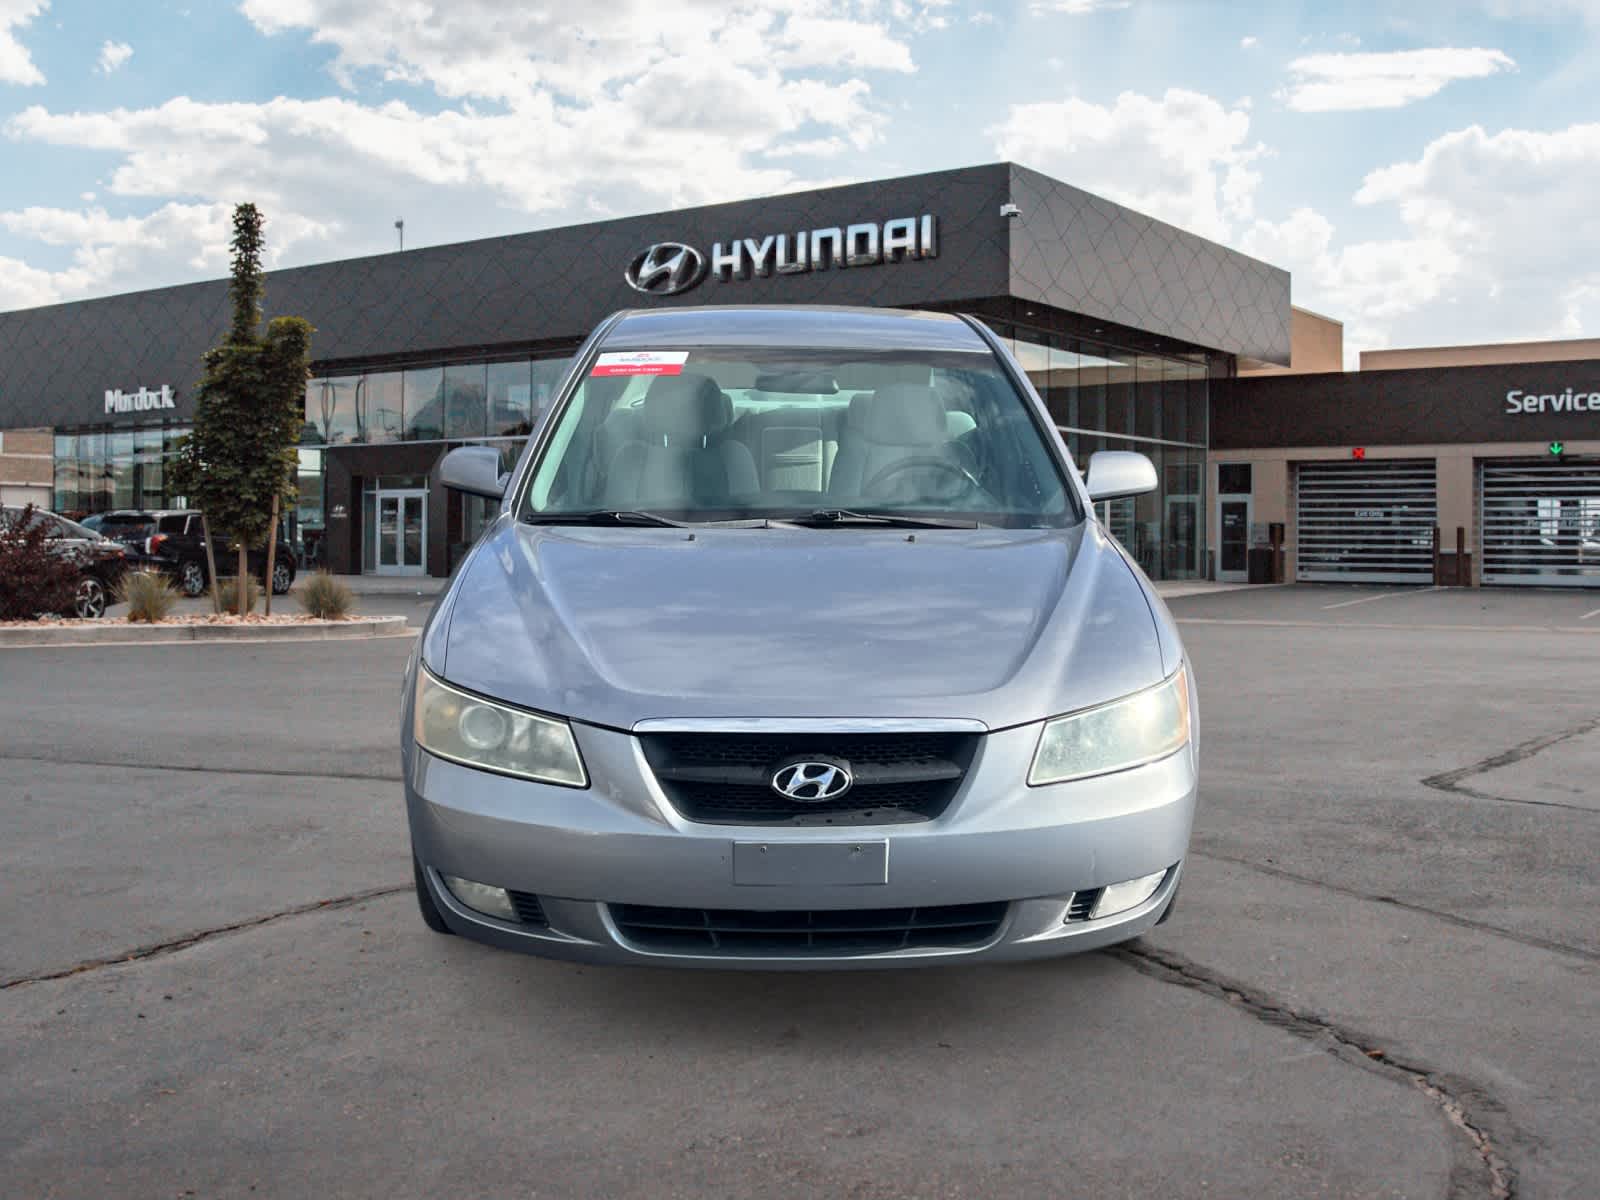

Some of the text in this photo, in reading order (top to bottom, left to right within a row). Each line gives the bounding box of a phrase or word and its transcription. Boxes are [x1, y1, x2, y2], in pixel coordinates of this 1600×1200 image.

[711, 213, 937, 281] HYUNDAI
[104, 384, 176, 414] Murdock
[1505, 387, 1600, 414] Service
